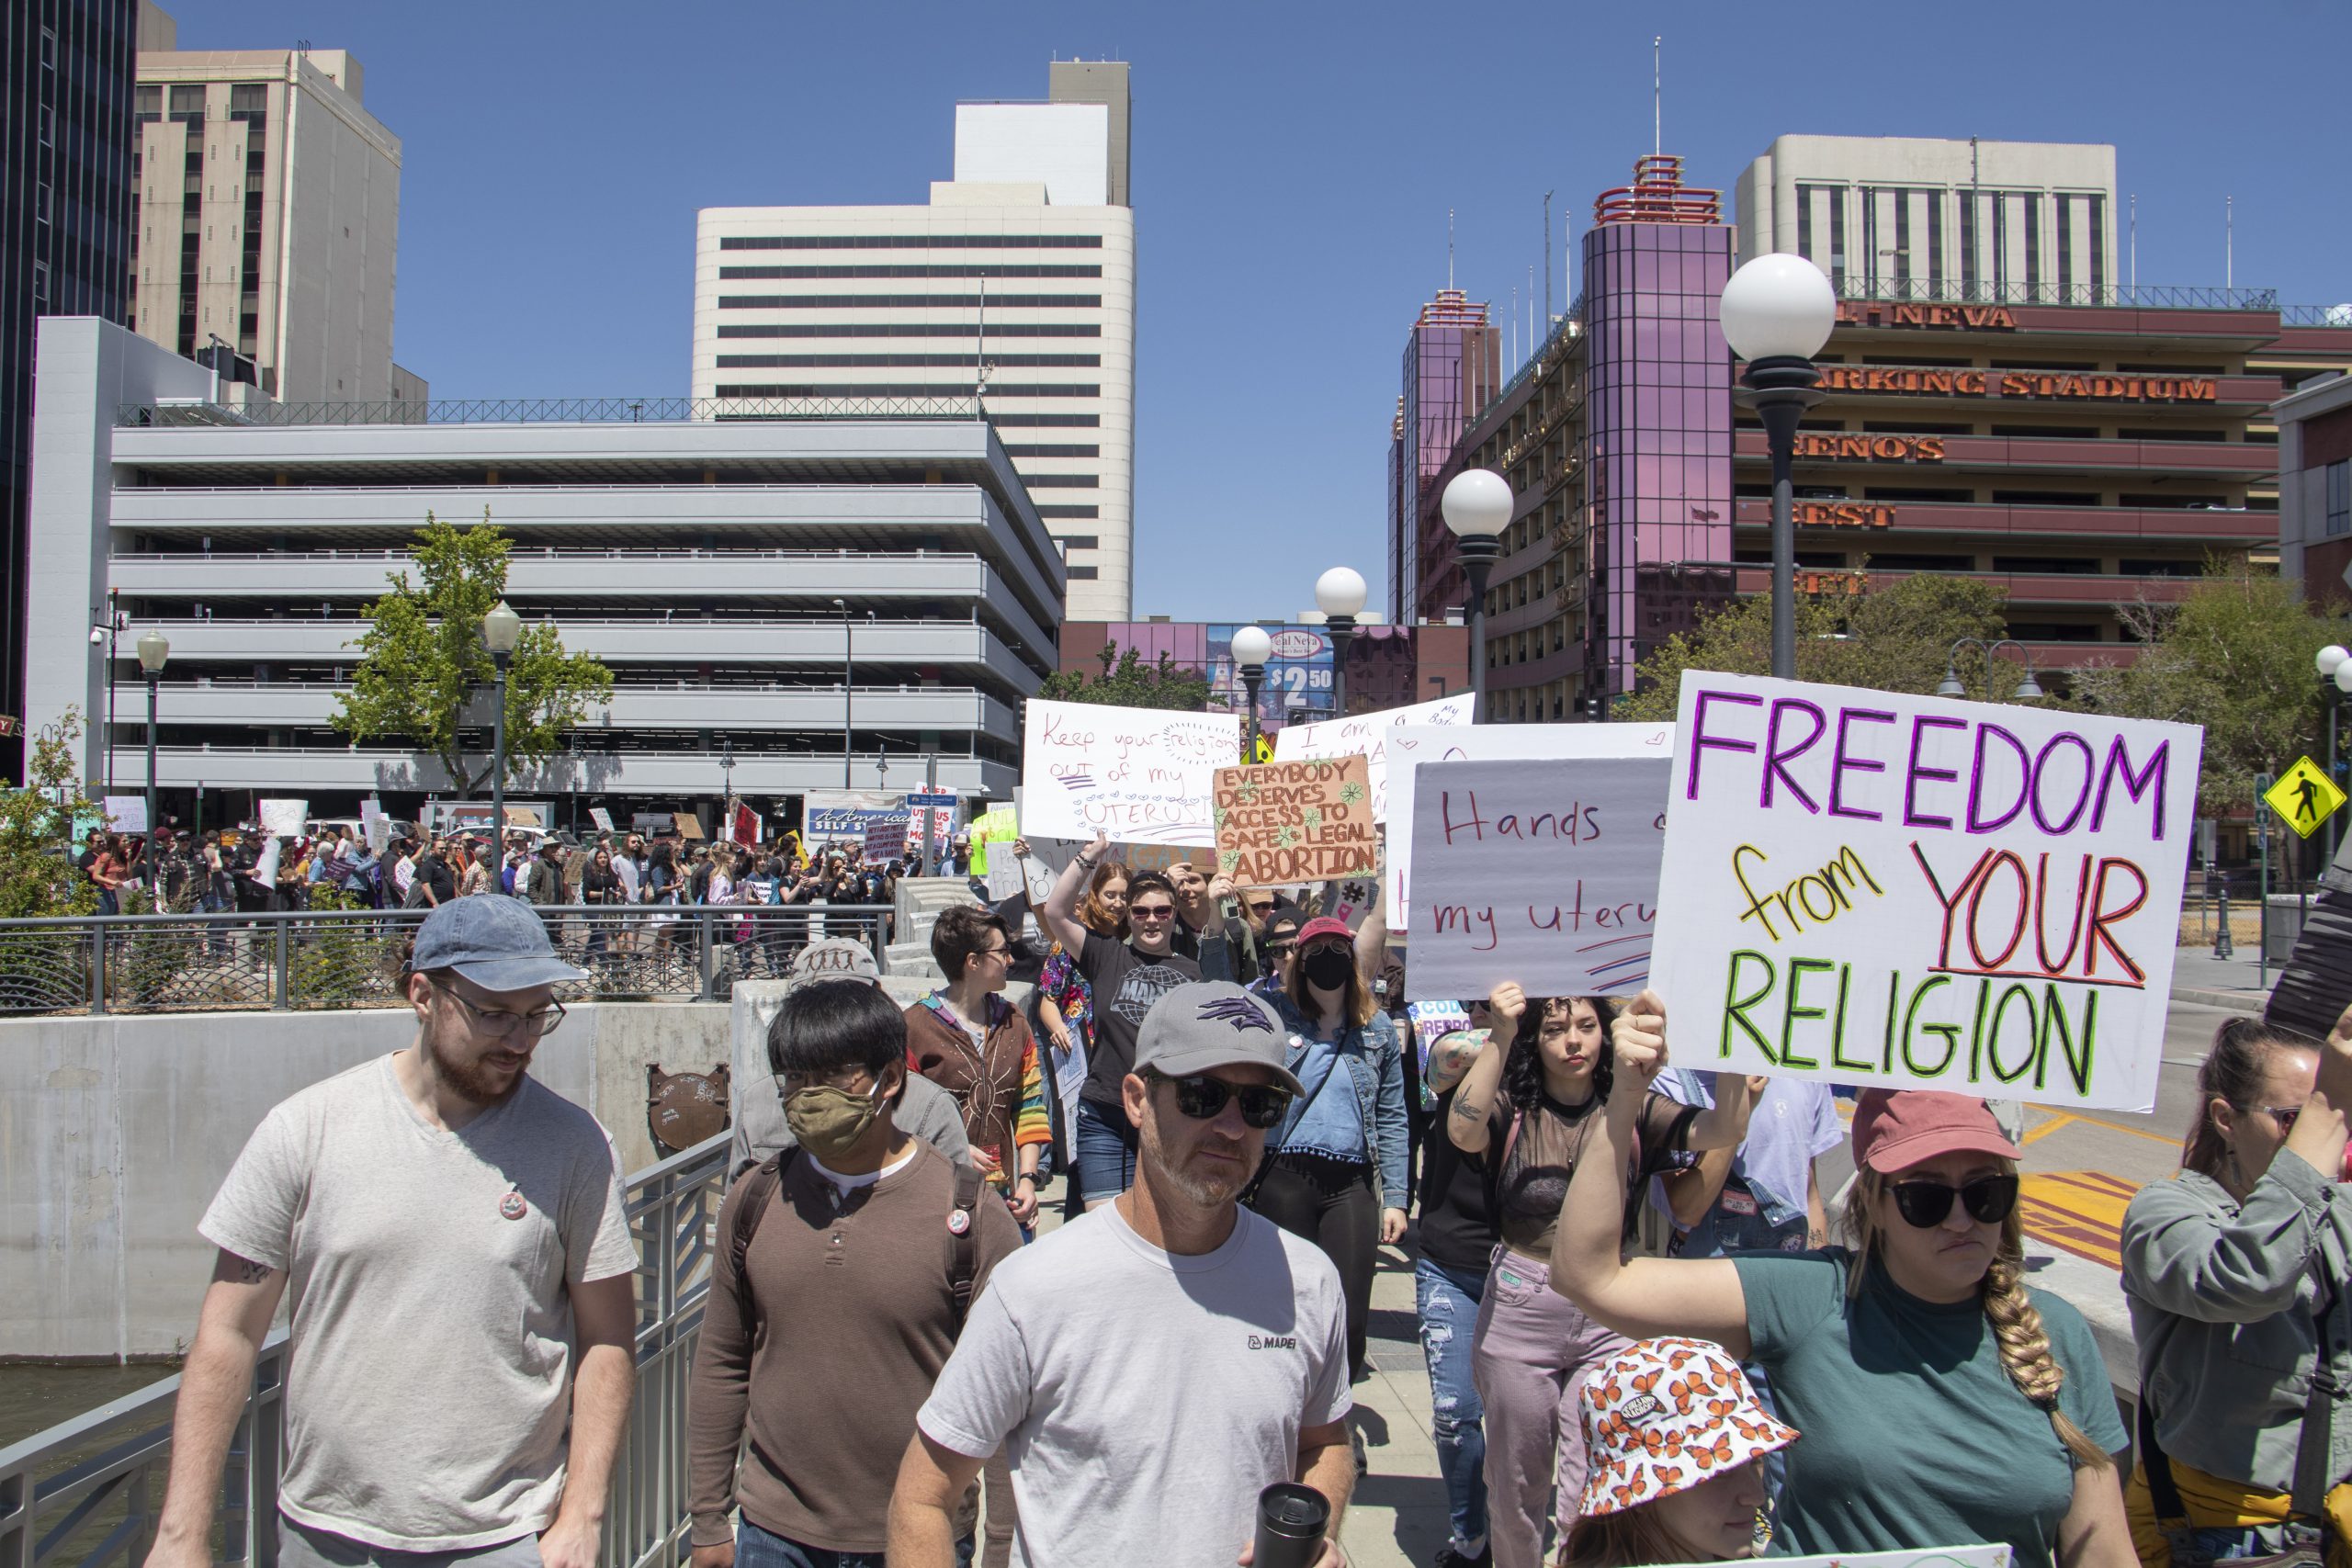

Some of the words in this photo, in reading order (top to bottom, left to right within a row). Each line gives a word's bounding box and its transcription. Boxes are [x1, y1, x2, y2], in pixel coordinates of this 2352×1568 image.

[1814, 367, 1986, 394] ARKING
[2000, 372, 2217, 400] STADIUM
[1793, 571, 1869, 595] ET
[1043, 713, 1095, 752] Keep
[1114, 733, 1159, 759] your
[1170, 732, 1239, 756] religion
[1301, 725, 1320, 749] I
[1340, 721, 1373, 739] am
[1223, 760, 1351, 787] EVERYBODY
[1687, 689, 2170, 841] FREEDOM
[922, 786, 947, 795] KEP
[1050, 763, 1093, 777] OUT
[1107, 761, 1130, 782] of
[1148, 768, 1185, 802] my
[1217, 784, 1327, 808] DESERVES
[815, 821, 848, 830] SELF
[912, 808, 949, 822] UTUS
[1084, 802, 1207, 824] UTERUS!
[1221, 806, 1306, 830] ACCESS
[1317, 802, 1349, 822] TO
[1442, 791, 1600, 846] Hands
[1221, 829, 1282, 851] SAFE
[1306, 823, 1374, 845] LEGAL
[1133, 843, 1193, 868] GAY
[1232, 845, 1374, 884] ABORTION
[1433, 904, 1498, 951] my
[1528, 879, 1657, 932] uteru
[1732, 843, 1884, 942] from
[1909, 840, 2147, 983] YOUR
[1423, 1019, 1474, 1036] REPRO
[1718, 950, 2099, 1098] RELIGION
[1263, 1337, 1296, 1349] MAPEI
